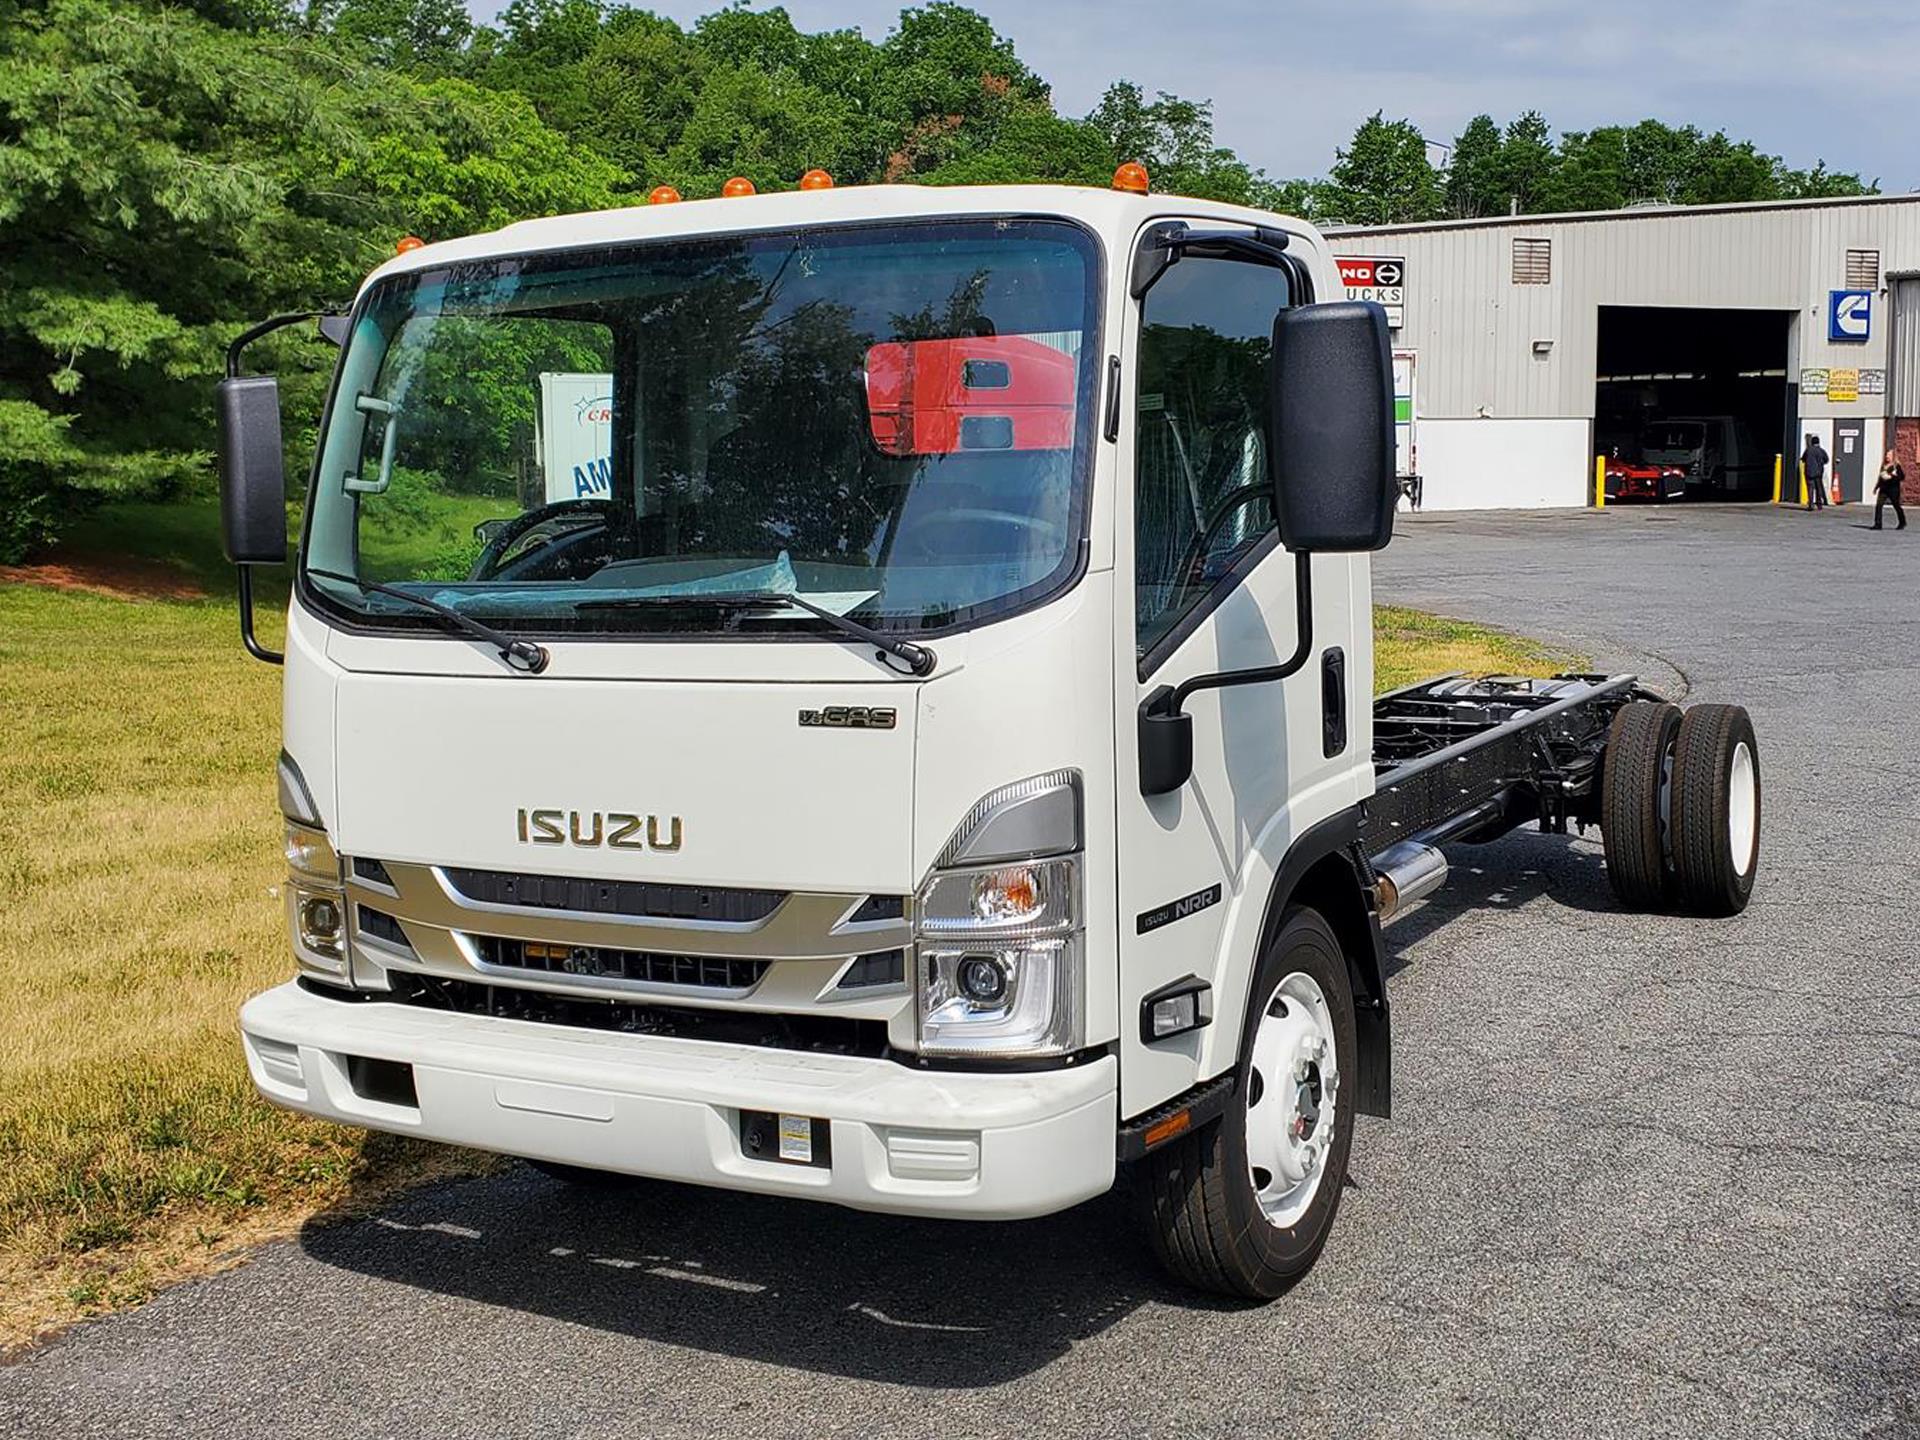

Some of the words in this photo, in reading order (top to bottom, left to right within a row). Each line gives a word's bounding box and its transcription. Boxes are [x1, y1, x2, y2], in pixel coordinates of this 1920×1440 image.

[1341, 268, 1370, 279] NO
[1346, 288, 1400, 301] UCKS
[573, 457, 613, 498] AM
[517, 808, 682, 851] ISUZU
[1144, 909, 1169, 927] ISUZU
[1175, 890, 1213, 918] NRR
